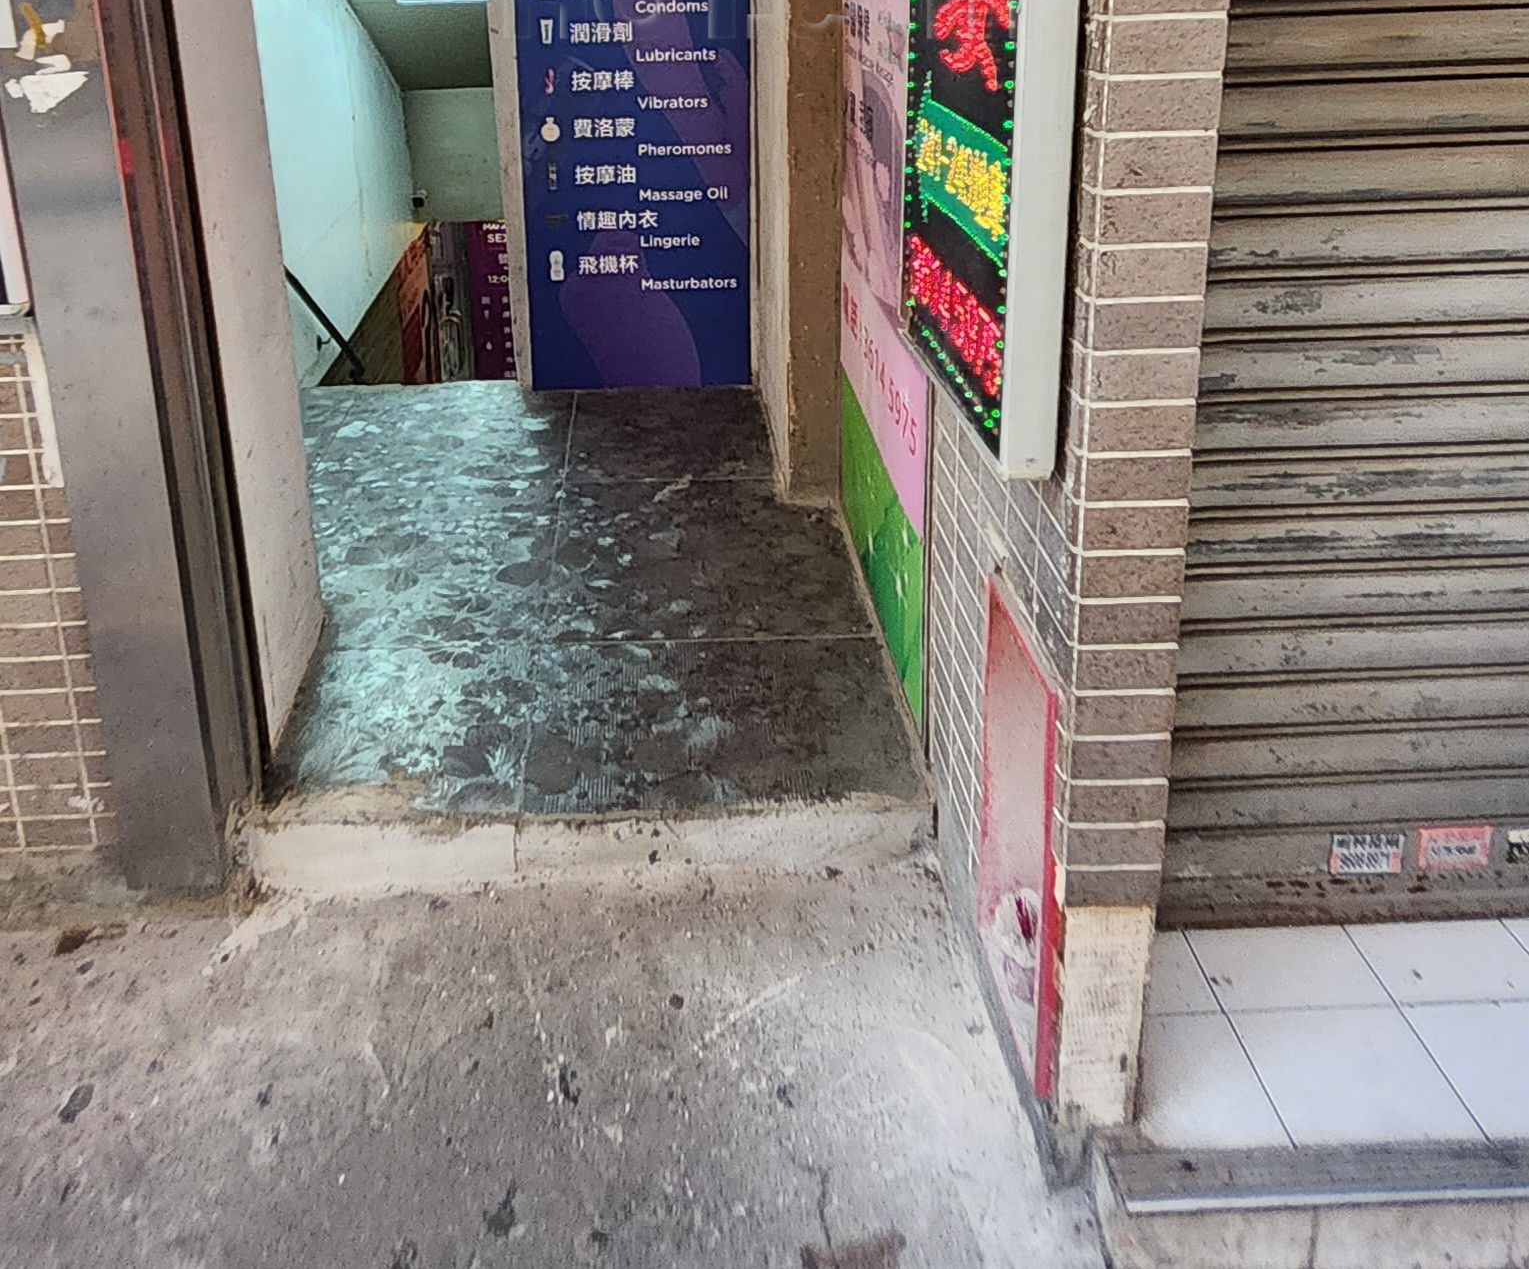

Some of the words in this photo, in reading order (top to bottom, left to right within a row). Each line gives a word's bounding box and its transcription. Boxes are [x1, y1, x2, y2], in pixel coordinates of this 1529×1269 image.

[635, 0, 709, 14] Condoms
[569, 20, 633, 44] 潤滑劑
[636, 47, 717, 63] Lubricants
[572, 70, 634, 92] 按摩棒
[637, 95, 709, 110] Vibrators
[573, 117, 636, 139] 費洛蒙
[638, 142, 732, 157] Pheromones
[575, 164, 637, 185] 按摩油
[638, 188, 703, 202] Massage
[707, 186, 729, 200] Oil
[639, 234, 700, 249] Lingerie
[578, 254, 639, 275] 飛機杯
[641, 277, 738, 291] Masturbators
[887, 376, 918, 457] 5975
